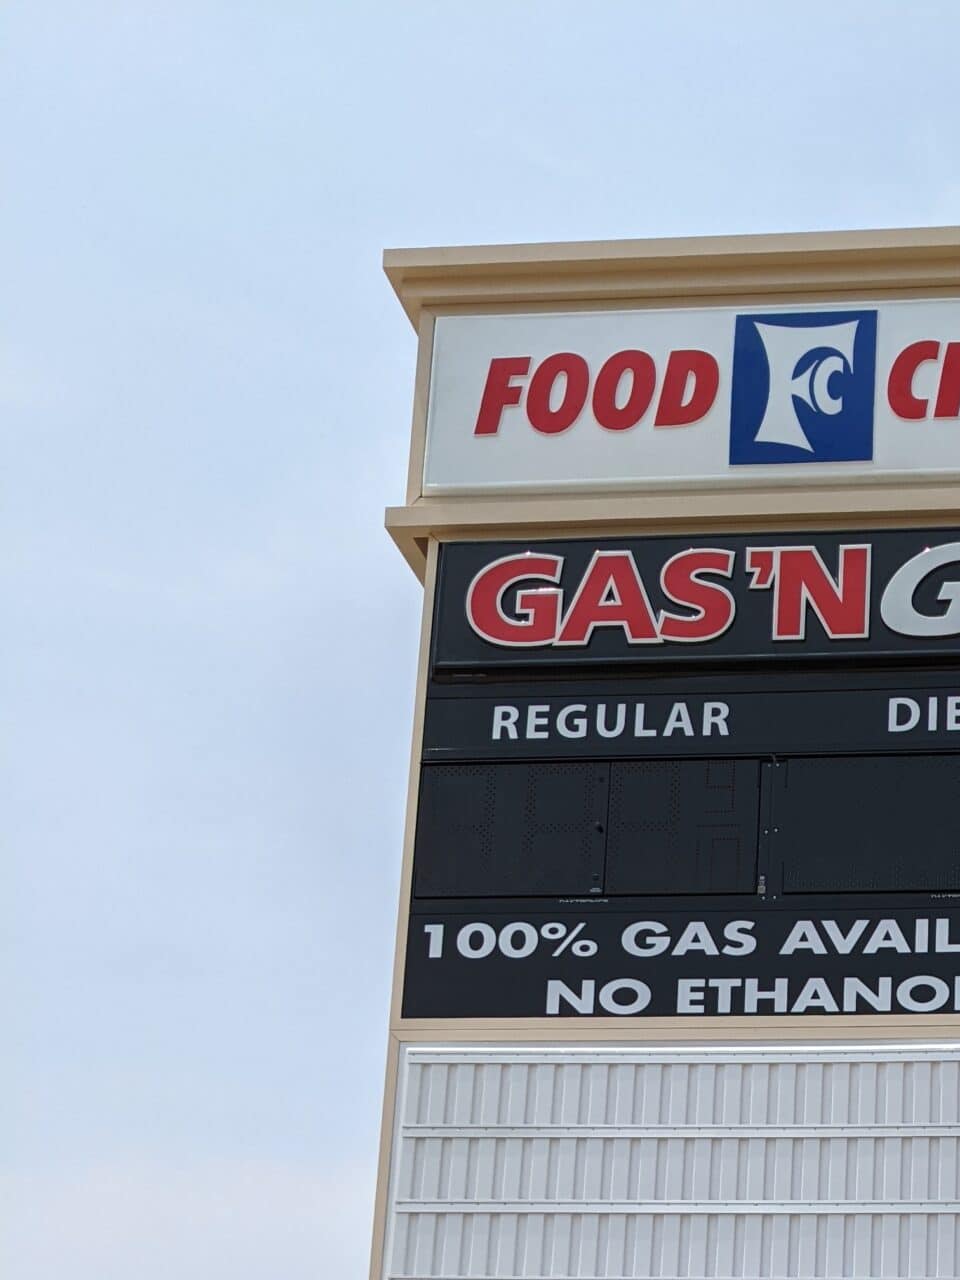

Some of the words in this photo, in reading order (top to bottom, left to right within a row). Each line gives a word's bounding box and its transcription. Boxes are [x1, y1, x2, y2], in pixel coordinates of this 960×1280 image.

[474, 350, 720, 435] FOOD
[491, 702, 731, 740] REGULAR
[424, 921, 599, 959] 100%
[621, 920, 757, 957] GAS
[544, 978, 651, 1015] NO
